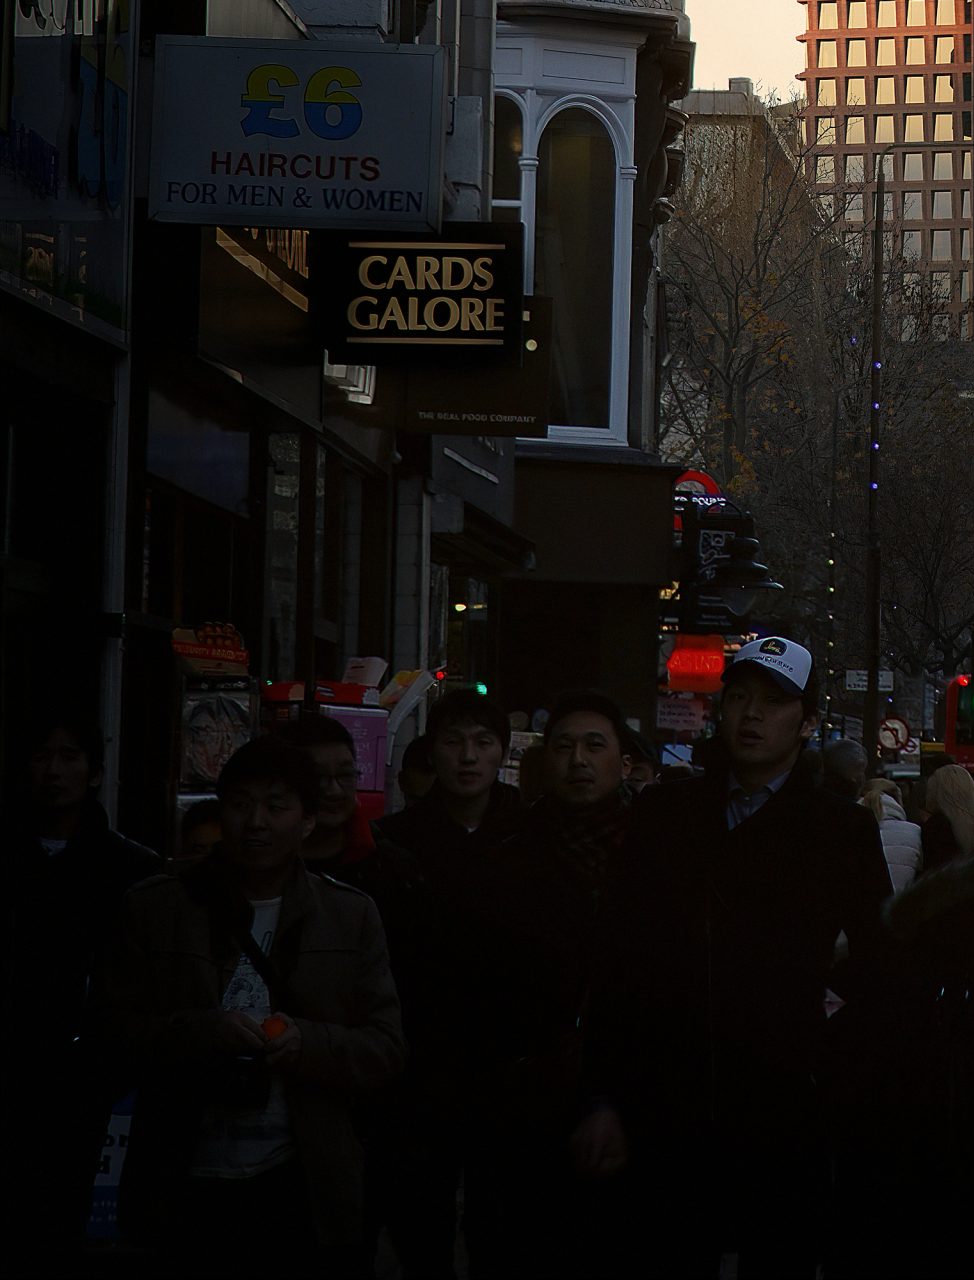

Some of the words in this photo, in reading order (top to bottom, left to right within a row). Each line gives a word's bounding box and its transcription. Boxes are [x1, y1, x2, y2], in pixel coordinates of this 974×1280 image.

[241, 64, 362, 140] £6
[211, 152, 380, 181] HAIRCUTS
[167, 182, 217, 205] FOR
[228, 185, 284, 208] MEN
[293, 187, 312, 208] &
[323, 188, 423, 213] WOMEN
[358, 255, 494, 292] CARDS
[347, 296, 505, 331] GALORE
[462, 412, 487, 421] FOOD
[490, 414, 536, 423] COMPANY
